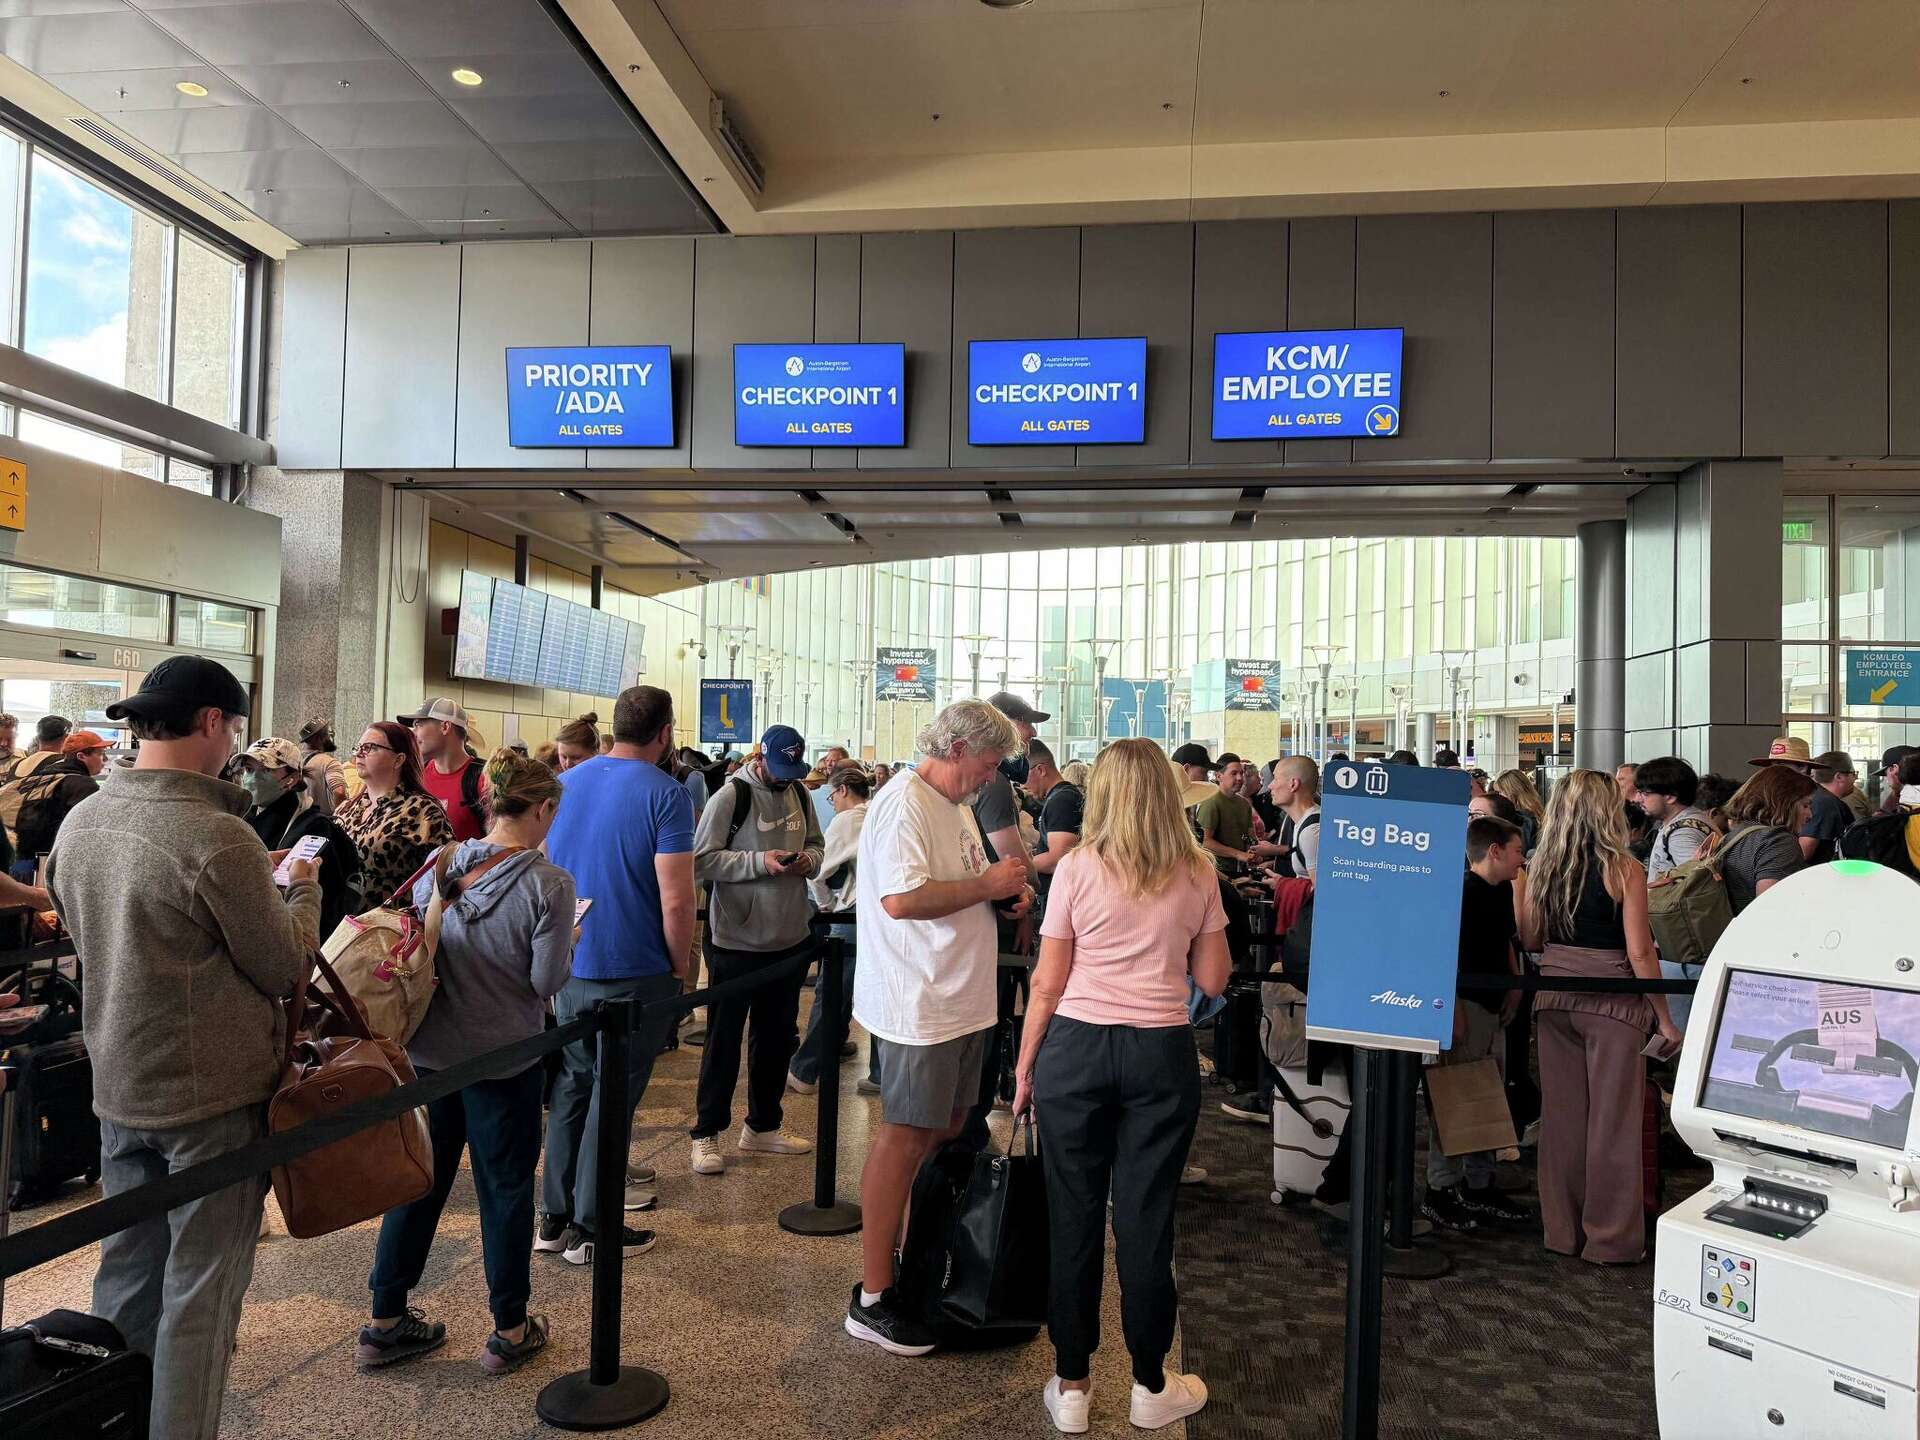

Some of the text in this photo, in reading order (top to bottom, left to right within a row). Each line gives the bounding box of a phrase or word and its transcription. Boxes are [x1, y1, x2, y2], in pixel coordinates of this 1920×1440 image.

[1266, 344, 1349, 371] KCM/
[525, 363, 652, 388] PRIORITY
[975, 382, 1138, 404] CHECKPOINT 1
[1222, 373, 1391, 401] EMPLOYEE
[554, 391, 624, 414] /ADA
[742, 386, 898, 406] CHECKPOINT 1
[1021, 419, 1090, 432] ALL GATES
[1268, 412, 1342, 426] ALL GATES
[558, 424, 623, 436] ALL GATES
[786, 423, 852, 434] ALL GATES
[883, 656, 930, 666] hyperspeed.
[1863, 653, 1905, 661] KCM/LEO
[1238, 661, 1260, 669] Invest
[1856, 661, 1913, 669] EMPLOYEES
[1231, 667, 1275, 677] hyperspeed.
[1858, 669, 1910, 677] ENTRANCE
[1547, 757, 1552, 765] 6
[1334, 819, 1431, 852] Tag Bag
[1333, 856, 1432, 874] Scan boarding pass to
[1332, 870, 1372, 882] print tag.
[1369, 989, 1424, 1009] Alaska
[1750, 991, 1771, 1000] select
[1822, 1009, 1861, 1025] AUS
[1836, 1372, 1856, 1383] CREDIT
[1856, 1378, 1873, 1389] CARD
